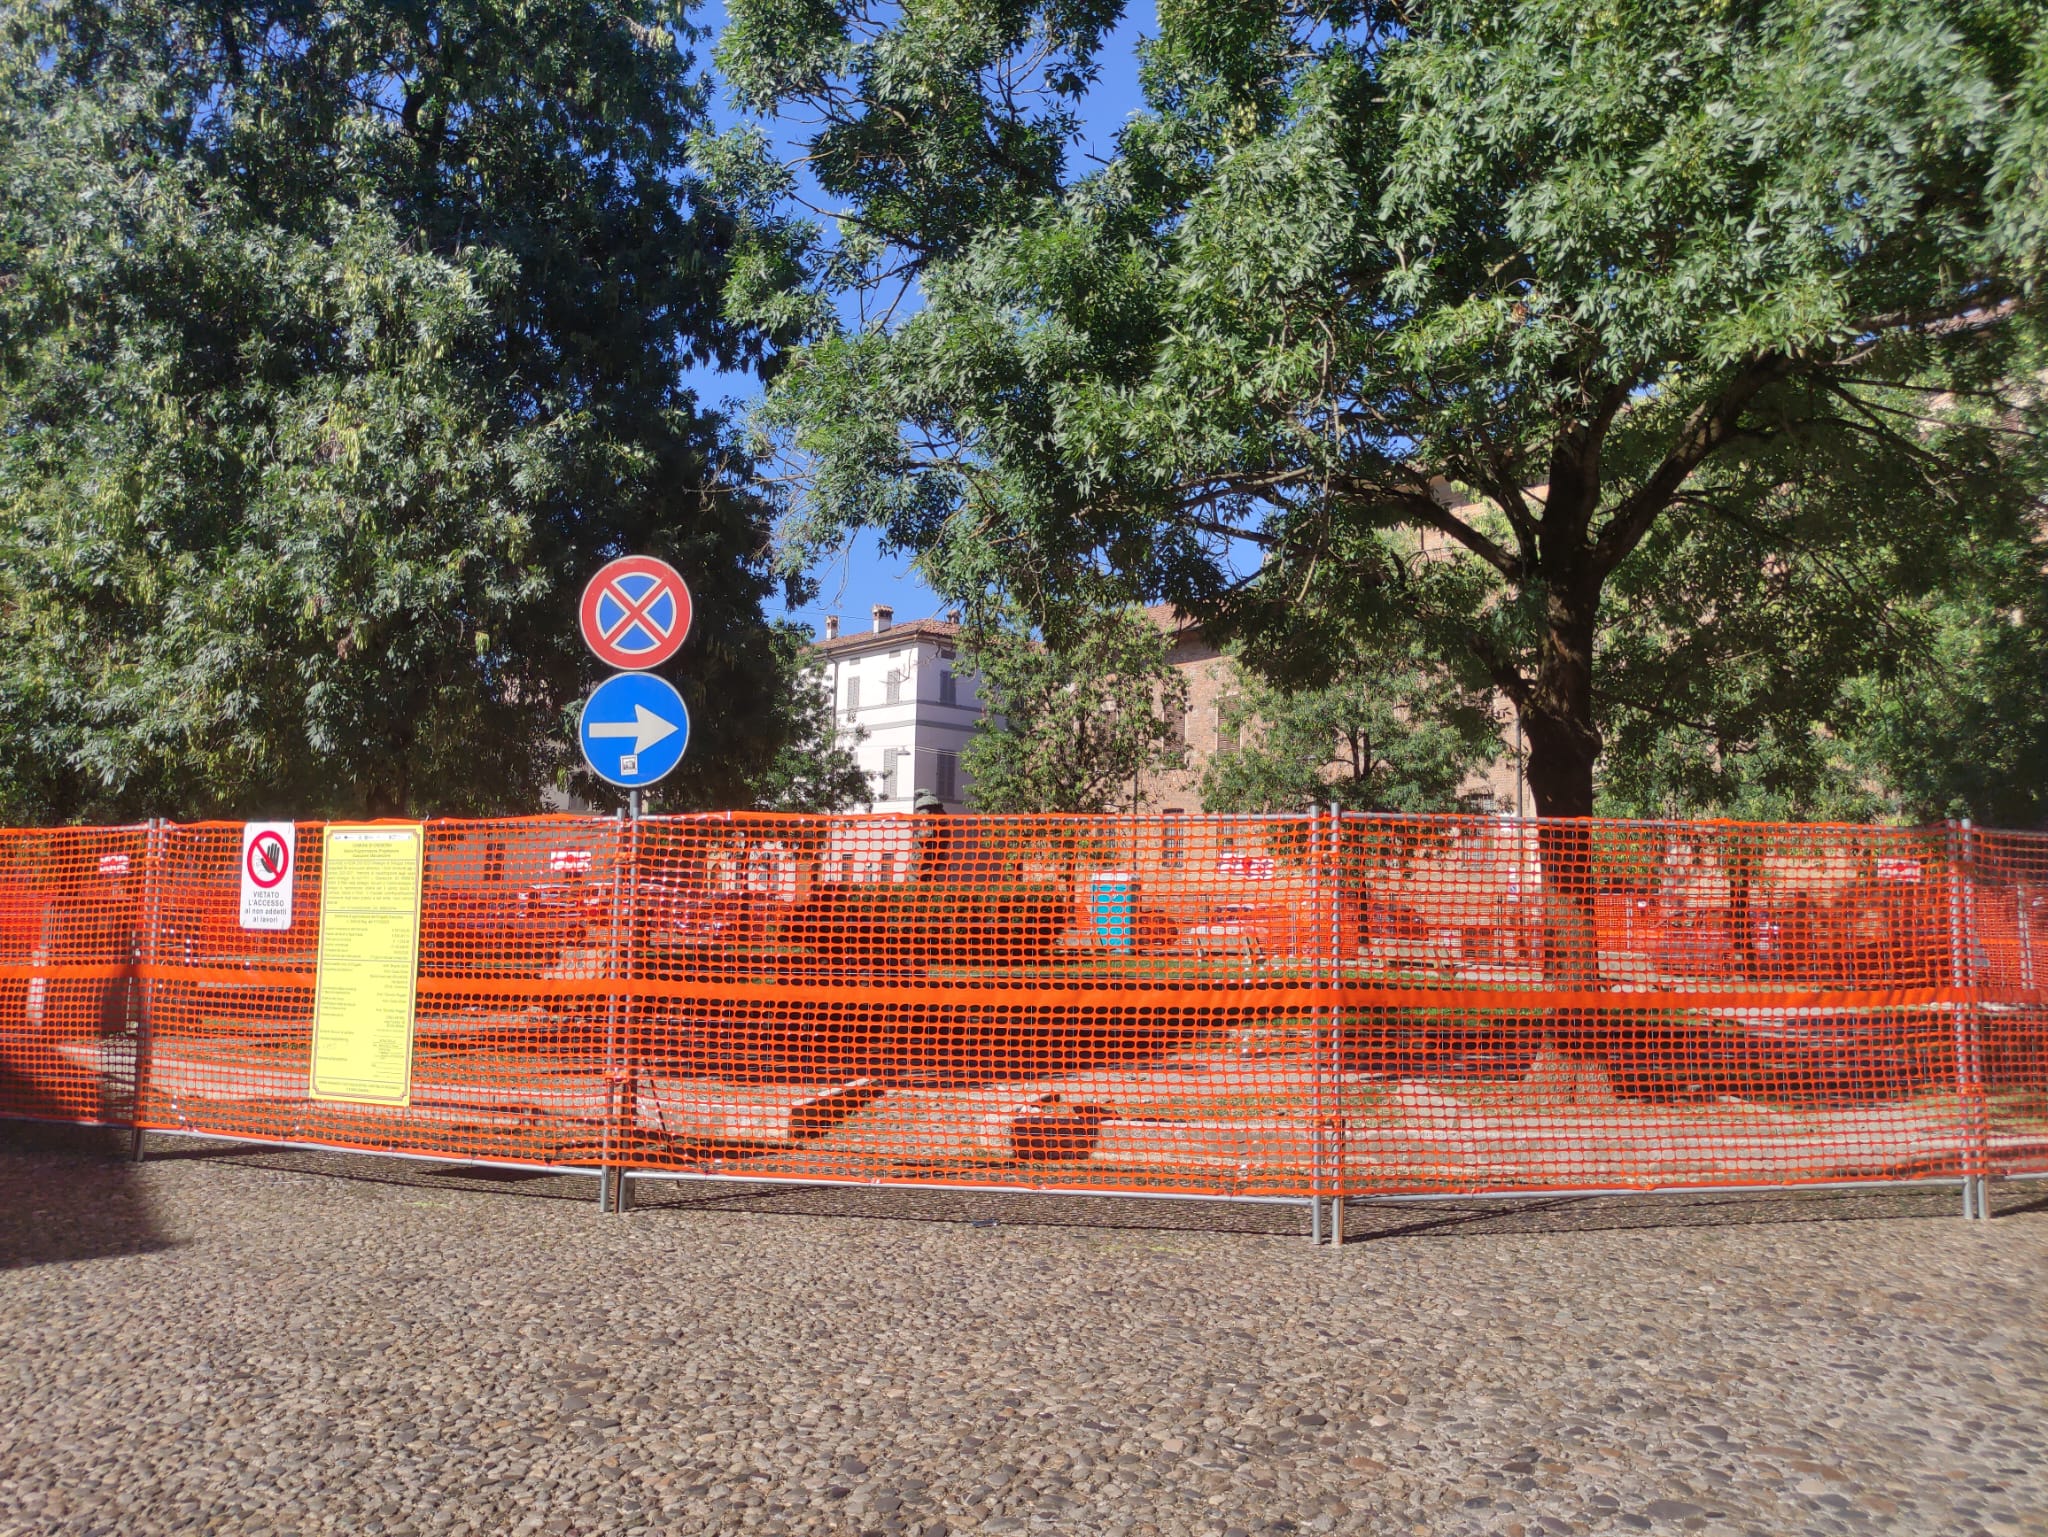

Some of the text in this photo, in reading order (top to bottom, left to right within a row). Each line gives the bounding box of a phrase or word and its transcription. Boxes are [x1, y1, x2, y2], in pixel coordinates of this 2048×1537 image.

[253, 890, 279, 898] VIETATO
[248, 899, 285, 907] L'ACCESSO
[265, 907, 287, 915] addetti
